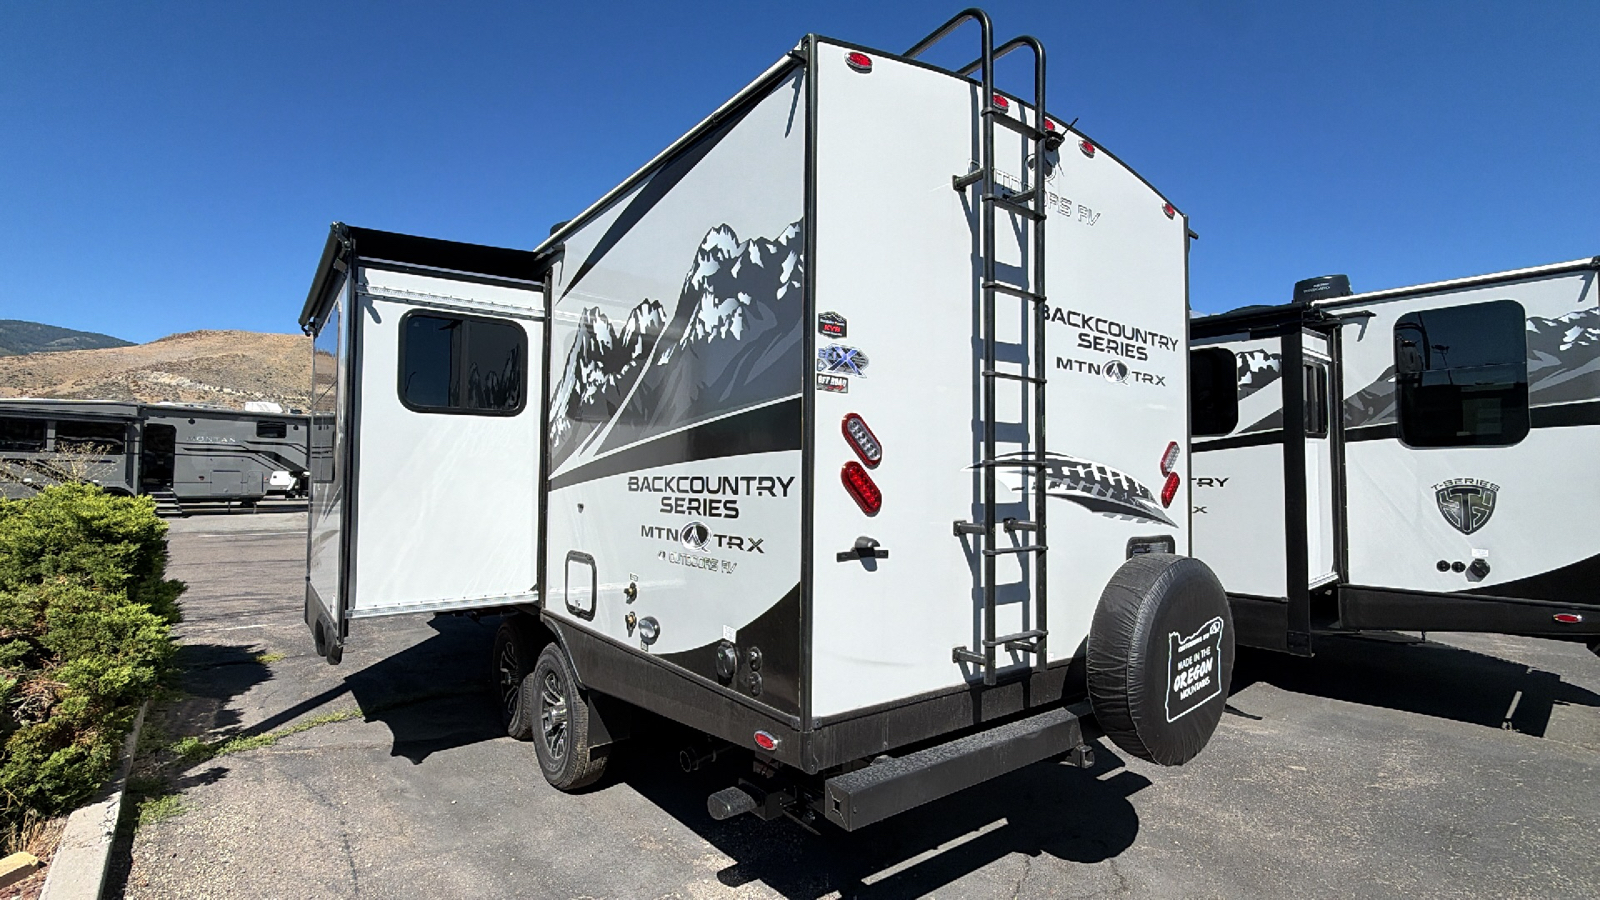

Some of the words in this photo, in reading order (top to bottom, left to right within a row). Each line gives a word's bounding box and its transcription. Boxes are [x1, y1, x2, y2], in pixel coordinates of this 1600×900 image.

[1077, 332, 1148, 361] SERIES
[1056, 356, 1101, 376] MTN
[1131, 370, 1166, 387] TRX
[627, 476, 796, 497] BACKCOUNTRY
[1431, 477, 1501, 492] T-SERIES
[659, 496, 740, 519] SERIES
[640, 524, 679, 542] MTN
[713, 533, 765, 554] TRX
[1177, 655, 1193, 671] MADE
[1193, 651, 1201, 662] IN
[1200, 645, 1211, 659] THE
[1173, 656, 1214, 693] OREGON
